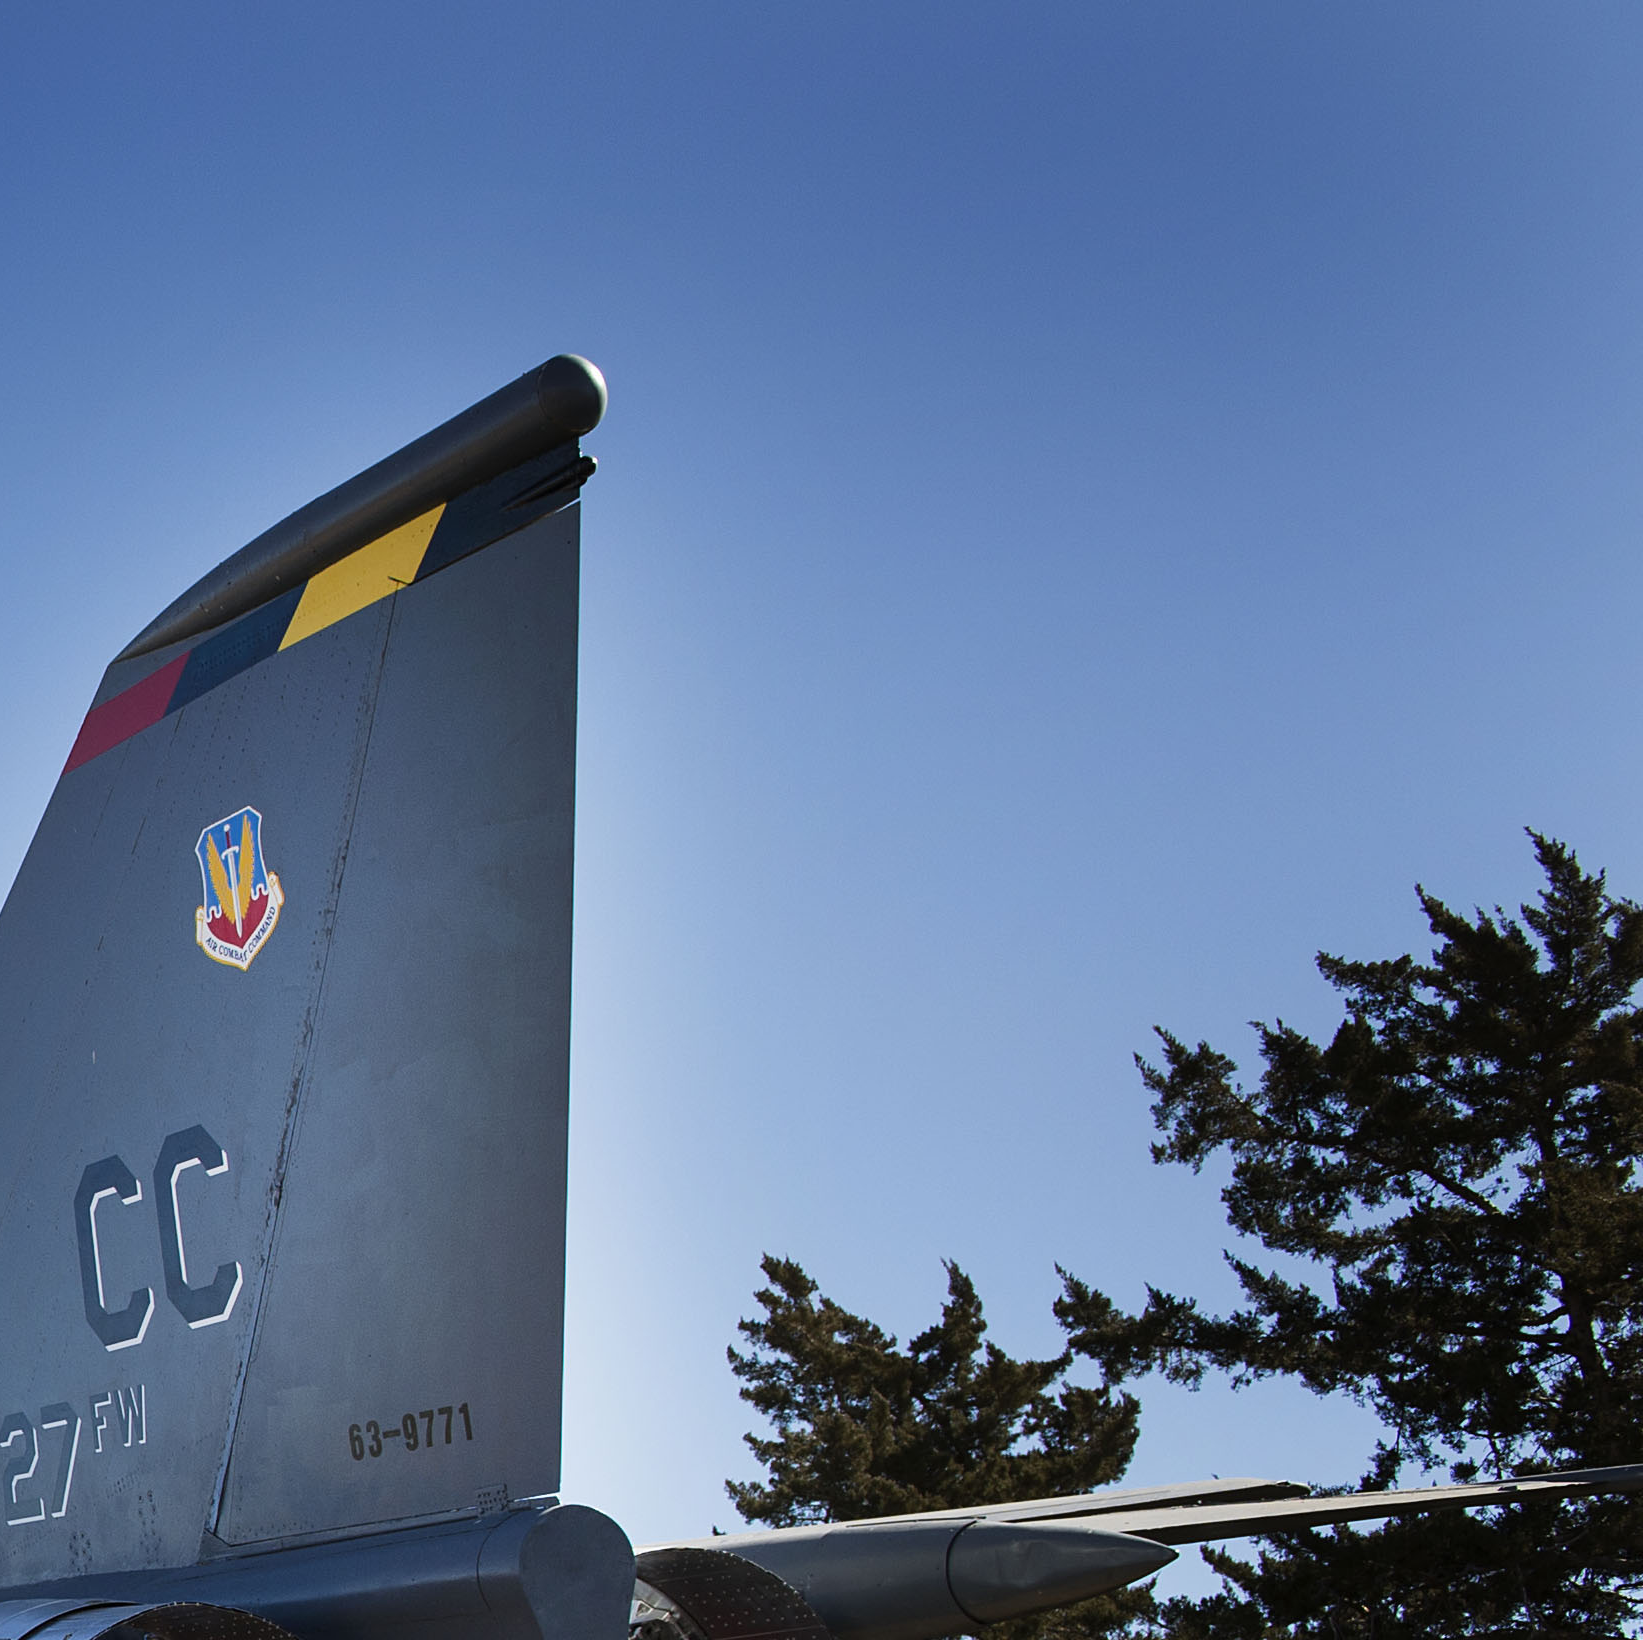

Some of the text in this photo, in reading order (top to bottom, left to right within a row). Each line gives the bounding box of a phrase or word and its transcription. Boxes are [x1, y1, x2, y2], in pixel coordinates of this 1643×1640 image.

[206, 906, 276, 962] AIR COMBAT COMMAND
[74, 1124, 243, 1351] CC
[348, 1402, 473, 1461] 63-9771
